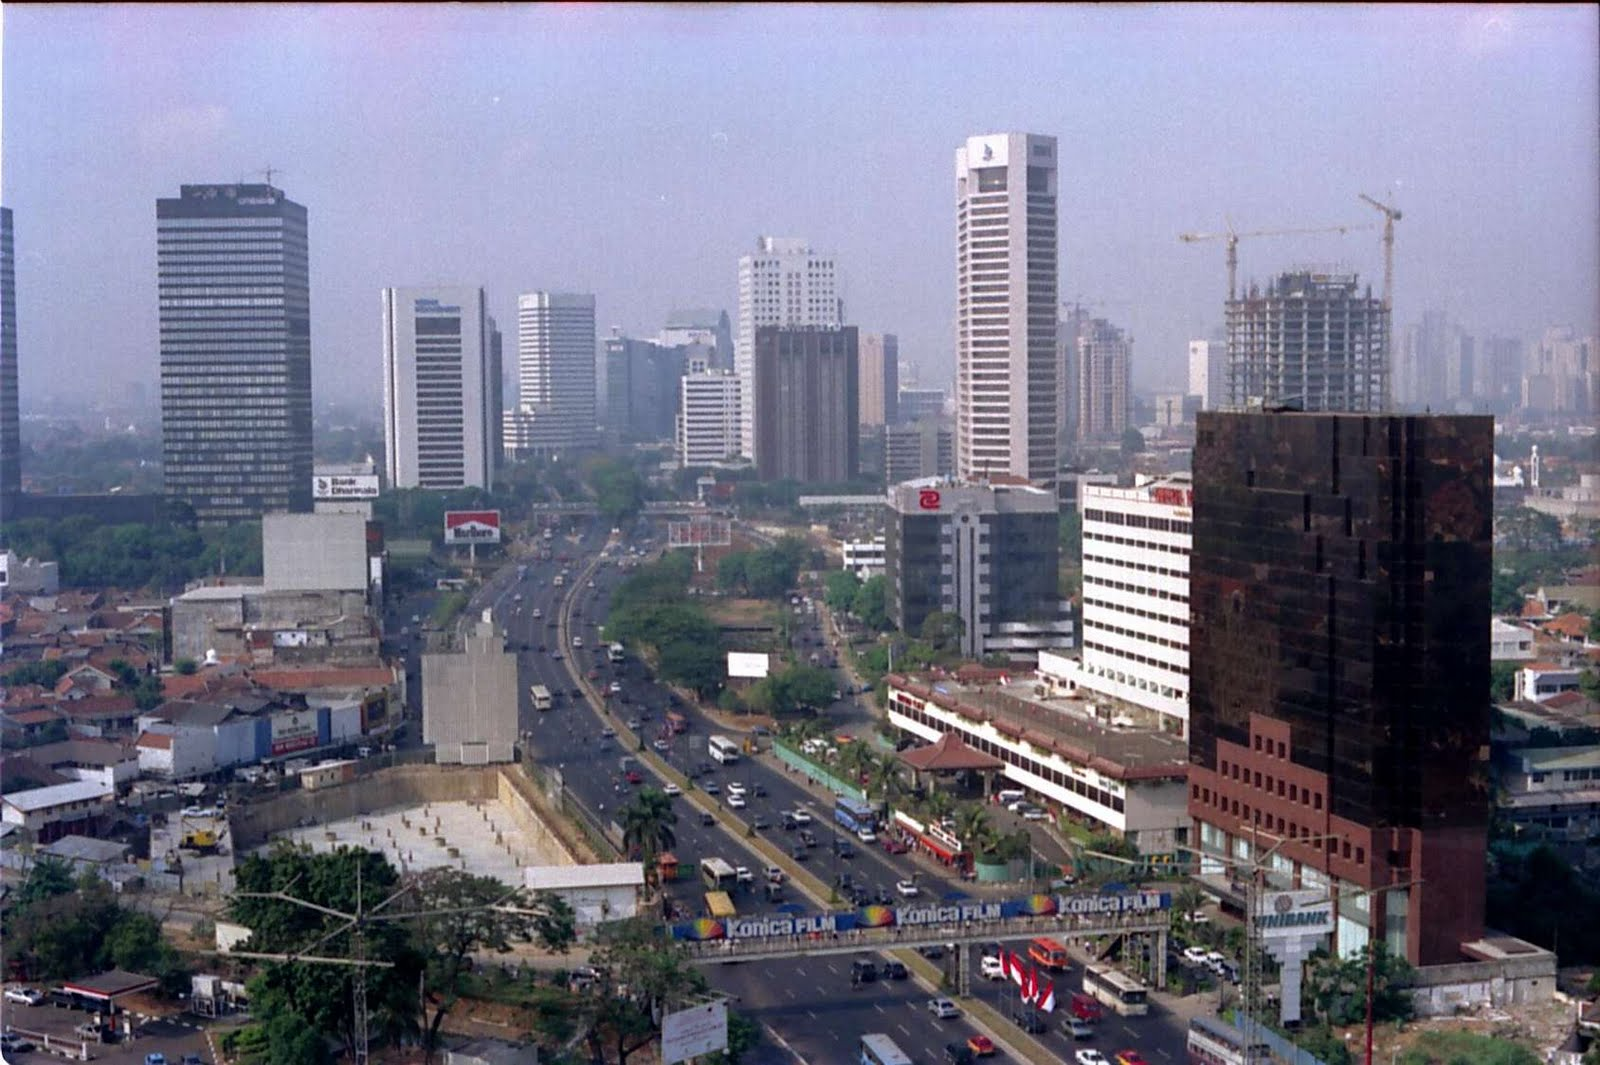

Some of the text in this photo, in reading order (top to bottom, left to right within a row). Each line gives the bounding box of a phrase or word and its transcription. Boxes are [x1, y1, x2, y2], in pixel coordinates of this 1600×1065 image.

[453, 525, 493, 538] Marlboro
[896, 902, 1000, 925] Konica FILM
[1059, 892, 1160, 914] Konica FILM
[726, 914, 836, 938] Konica FILM
